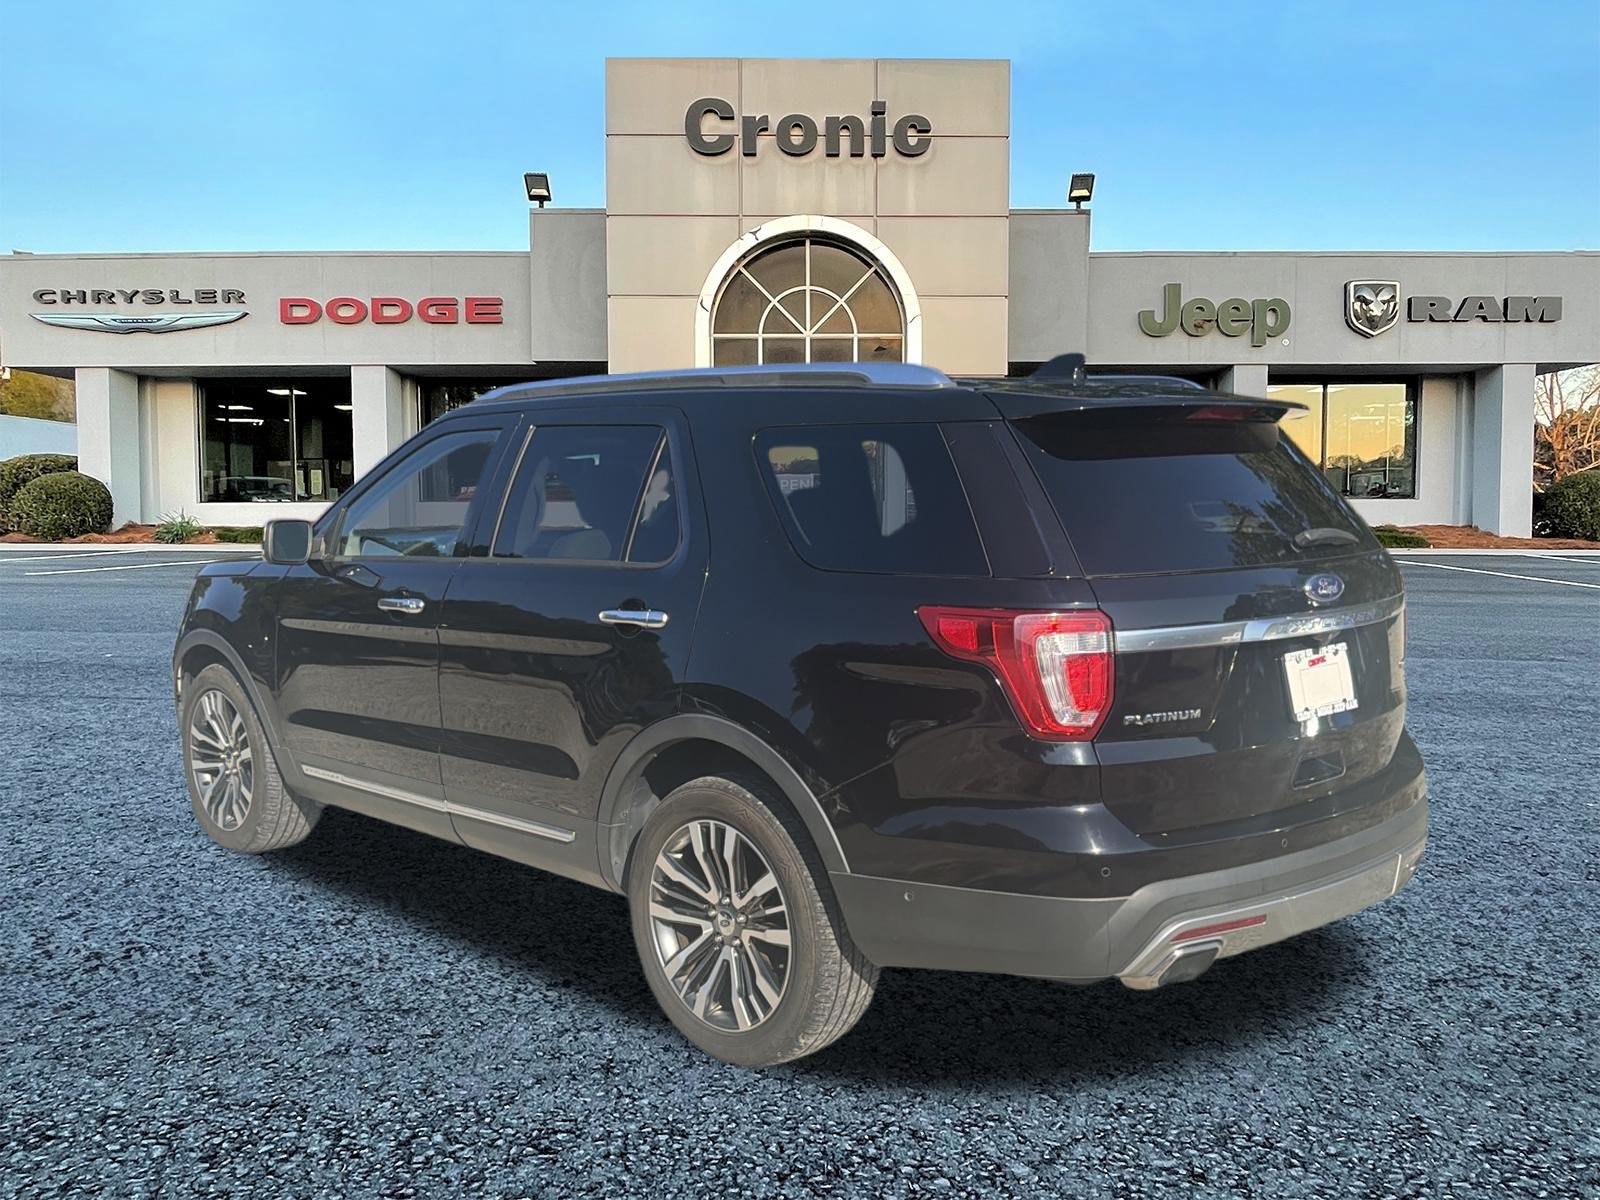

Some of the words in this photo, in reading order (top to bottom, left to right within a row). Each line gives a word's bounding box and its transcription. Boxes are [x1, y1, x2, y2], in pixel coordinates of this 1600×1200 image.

[685, 97, 932, 157] Cronic
[32, 289, 247, 304] CHRYSLER
[1407, 296, 1563, 322] RAM
[279, 297, 503, 324] DODGE
[1138, 283, 1291, 347] Jeep
[1123, 708, 1202, 726] PLATINUM
